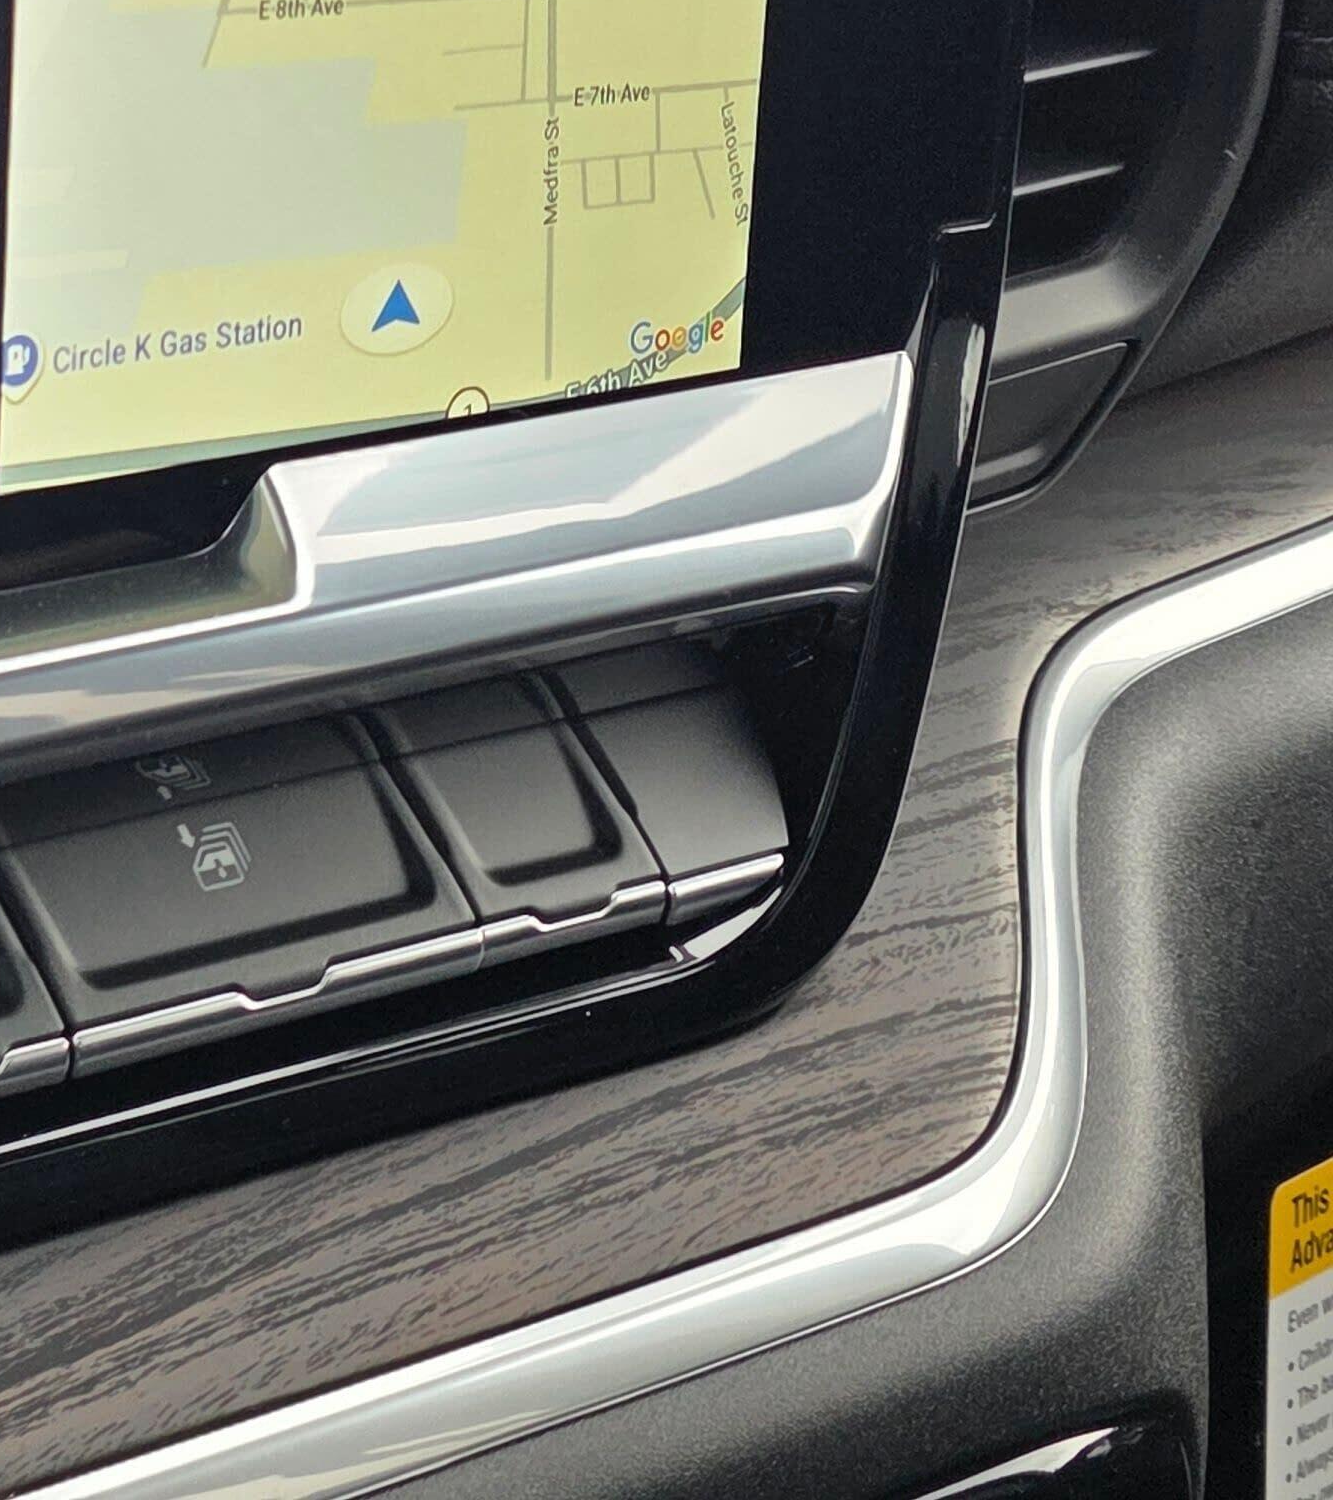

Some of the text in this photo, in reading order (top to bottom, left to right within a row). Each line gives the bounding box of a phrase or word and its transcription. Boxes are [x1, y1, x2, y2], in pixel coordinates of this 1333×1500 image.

[258, 0, 270, 21] E
[573, 83, 651, 107] E 7th Ave
[542, 116, 560, 226] Medfra St
[720, 101, 749, 227] Latouche St
[53, 314, 303, 374] Circle K Gas Station
[630, 310, 725, 354] Google
[586, 371, 622, 395] 6th
[627, 353, 668, 387] Ave
[1291, 1184, 1330, 1229] This
